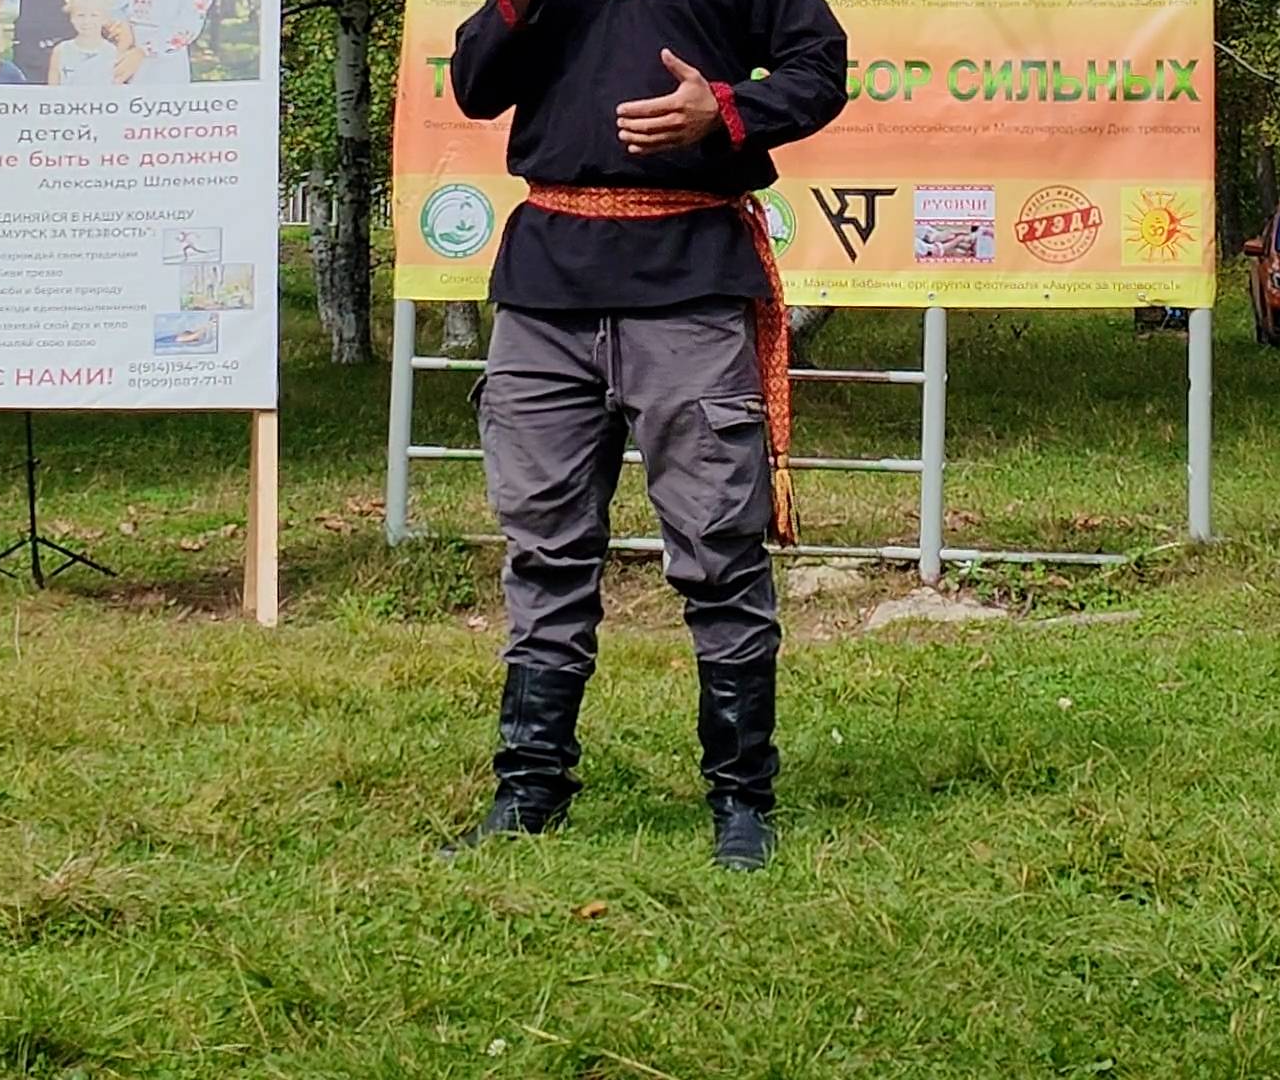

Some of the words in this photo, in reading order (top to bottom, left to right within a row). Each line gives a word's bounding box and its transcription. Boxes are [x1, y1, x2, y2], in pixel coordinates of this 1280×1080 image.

[946, 58, 1202, 102] СИЛЬНЫХ
[39, 100, 118, 115] важно
[129, 96, 239, 118] будущее
[18, 124, 98, 143] детей,
[123, 124, 239, 140] алкоголя
[29, 150, 90, 167] быть
[101, 153, 130, 166] не
[139, 150, 239, 167] должно
[38, 177, 138, 191] Александр
[144, 174, 239, 188] Шлеменко
[922, 198, 988, 211] РУСИЧИ
[83, 211, 124, 223] НАШУ
[128, 209, 195, 222] КОМАНДУ
[52, 228, 67, 239] ЗА
[128, 359, 240, 375] 8(914)194-70-40
[15, 367, 113, 387] НАМИ!
